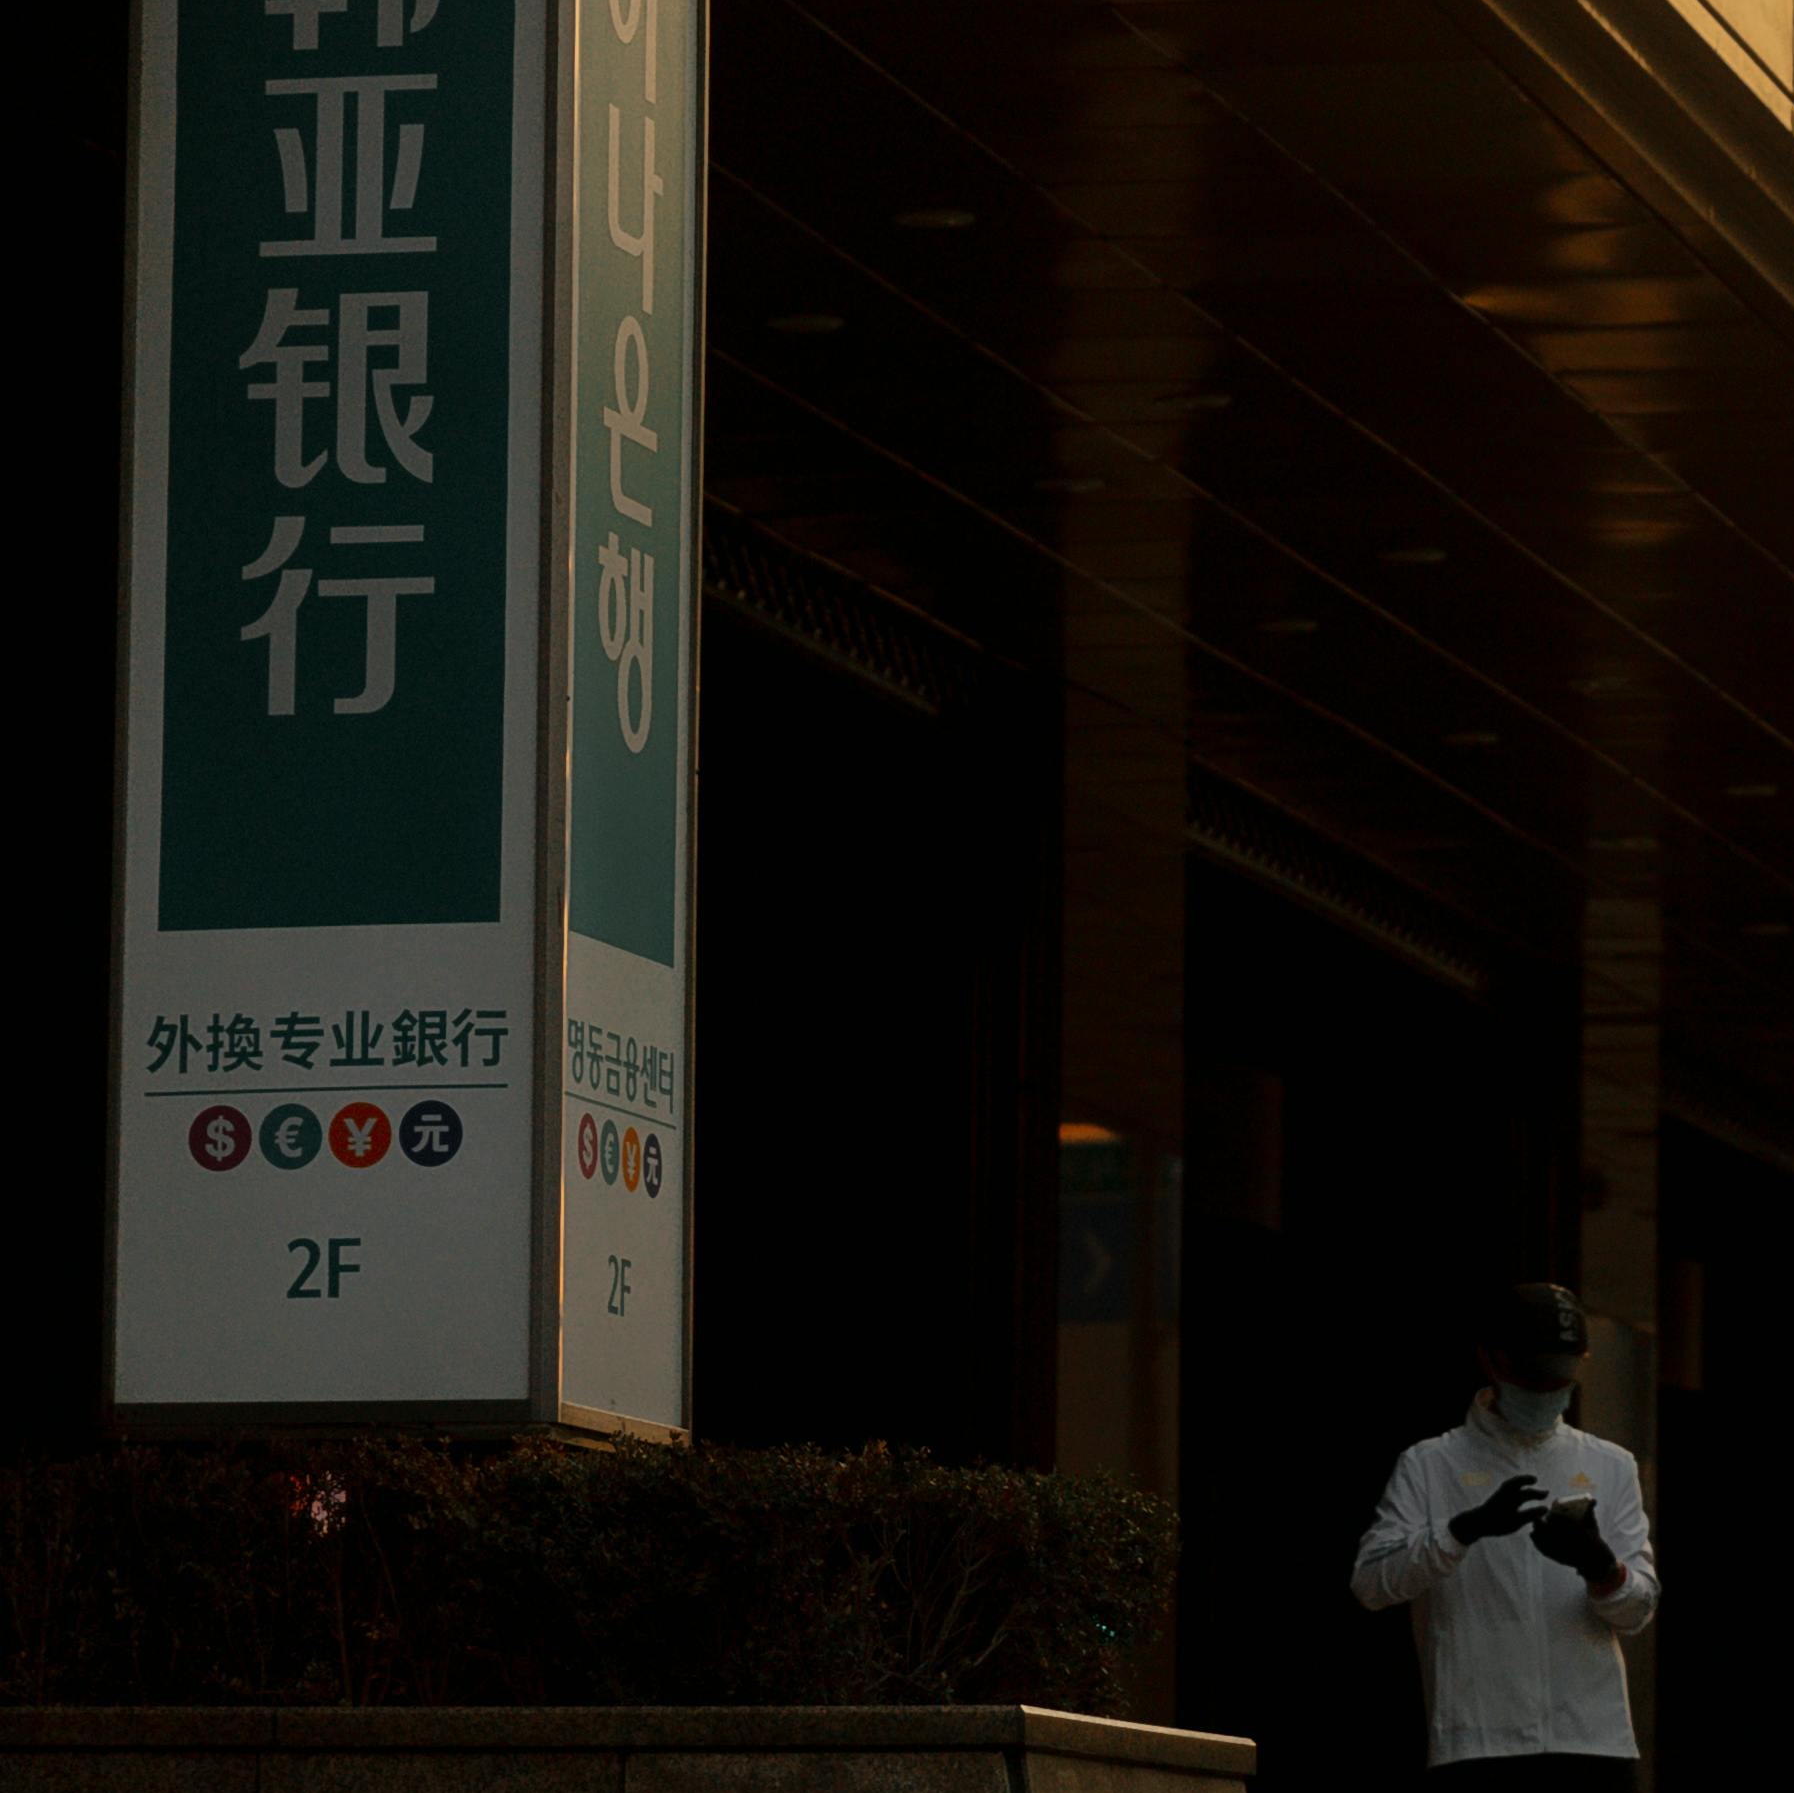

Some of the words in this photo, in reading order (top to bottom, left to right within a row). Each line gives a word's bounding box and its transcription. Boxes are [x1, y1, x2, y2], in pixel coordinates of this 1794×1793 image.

[568, 1018, 674, 1114] 명동금융센터
[204, 1115, 236, 1163] $
[274, 1116, 305, 1159] €
[343, 1117, 378, 1159] ¥
[411, 1114, 451, 1154] 元
[286, 1237, 362, 1300] 2F
[606, 1253, 633, 1318] 2F
